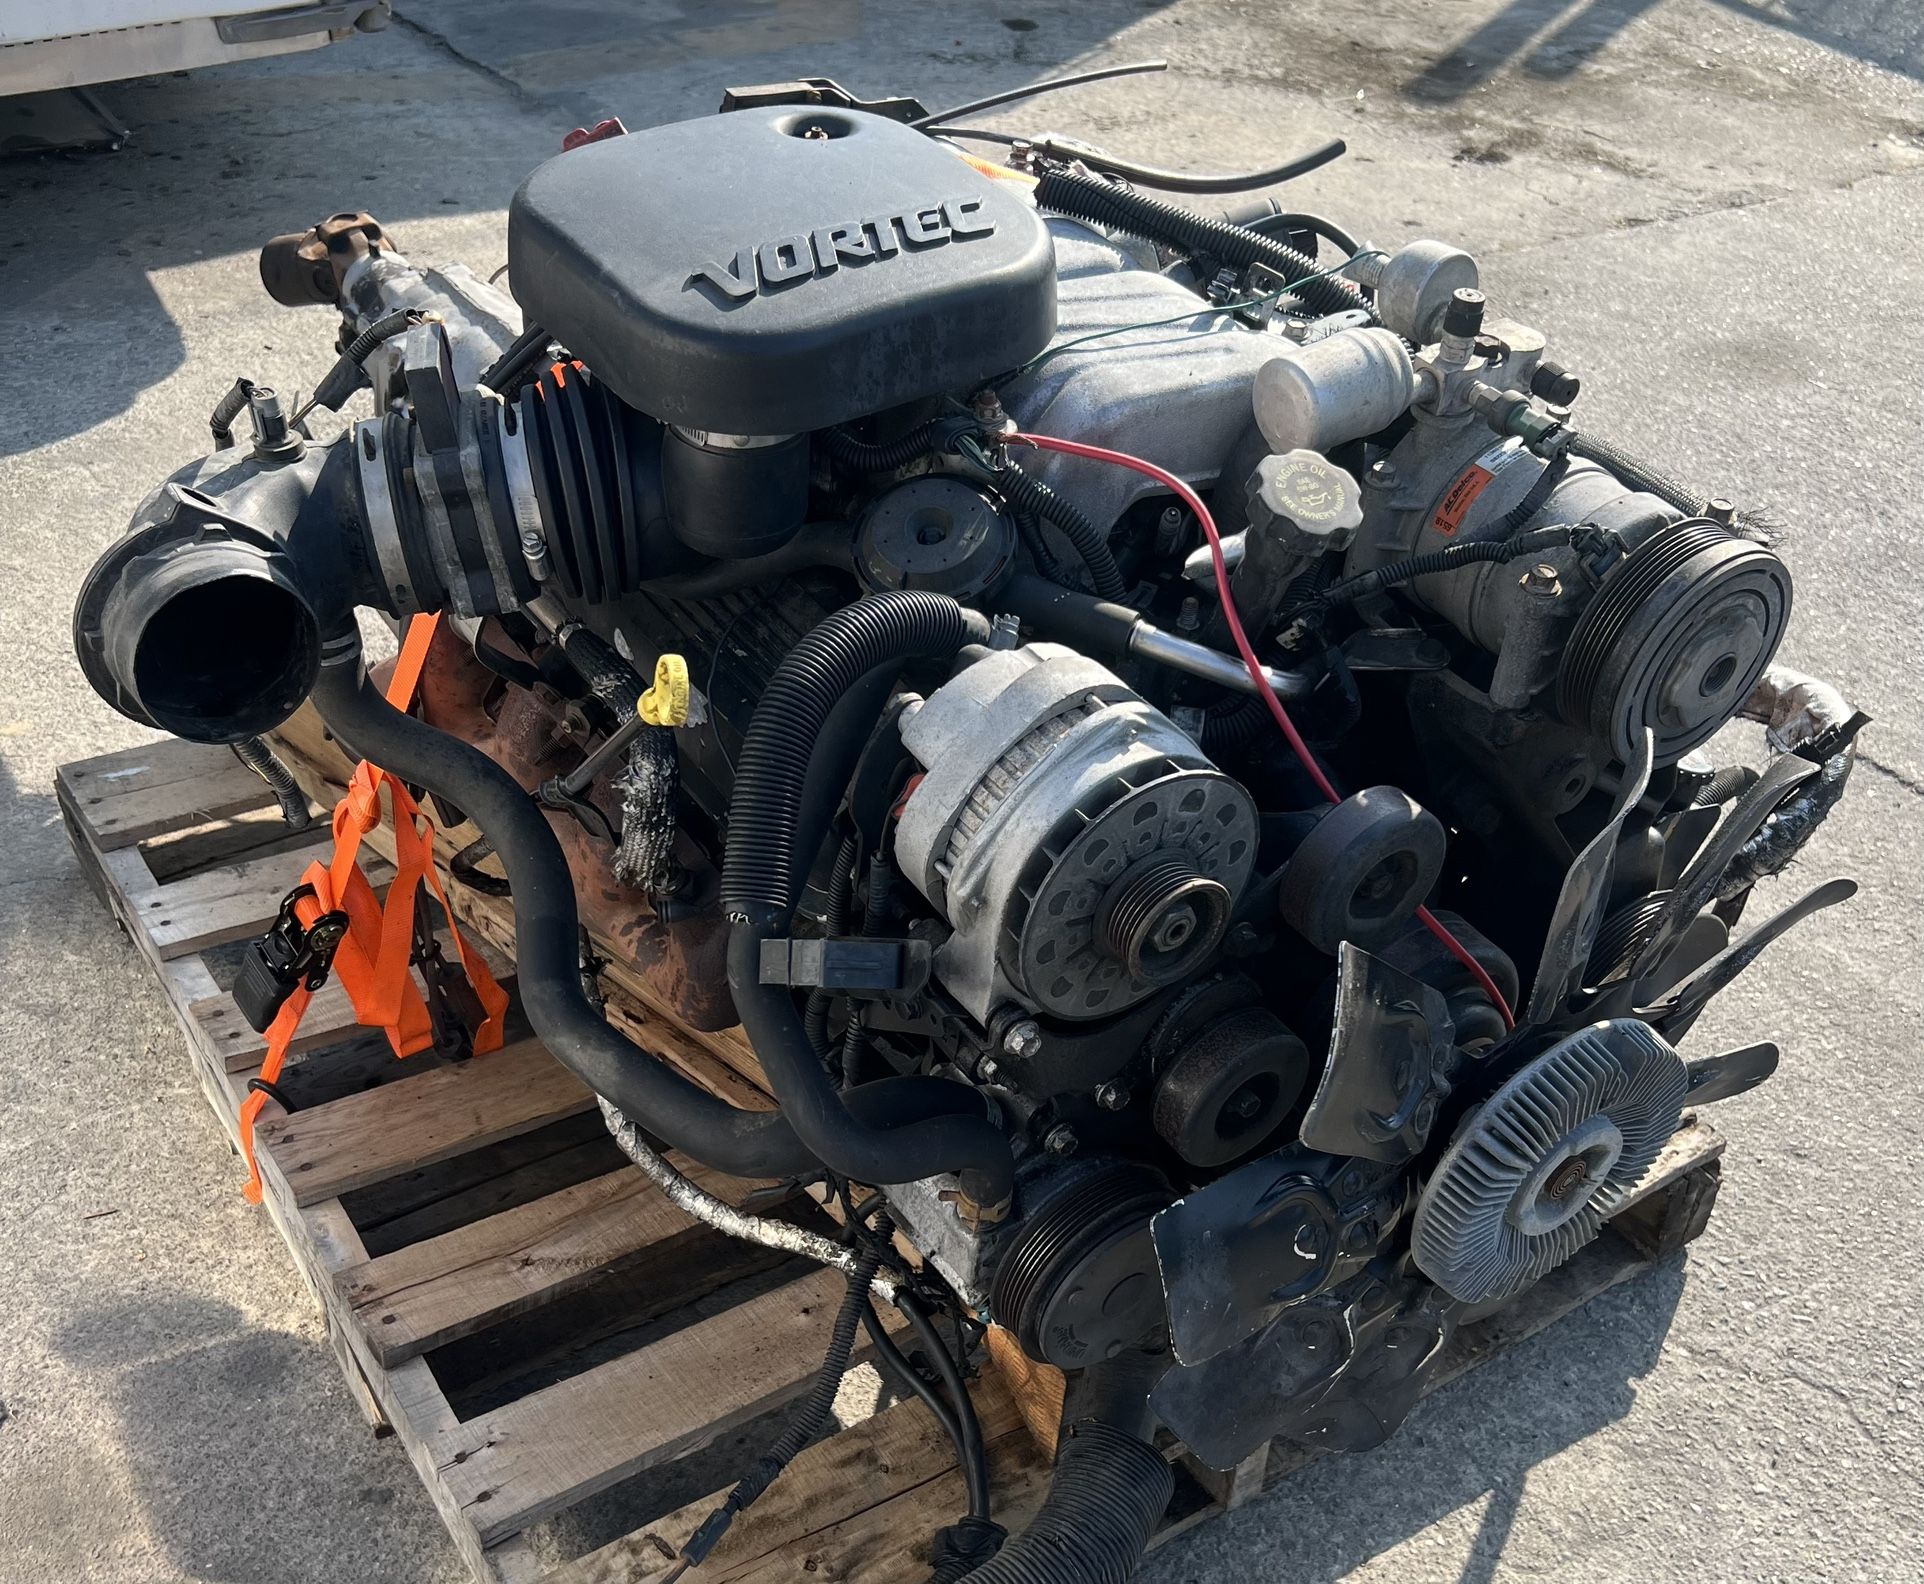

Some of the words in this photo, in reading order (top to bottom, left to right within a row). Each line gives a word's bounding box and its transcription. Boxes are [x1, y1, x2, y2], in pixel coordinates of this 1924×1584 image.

[687, 195, 997, 303] VORTEC
[1275, 462, 1307, 489] ENGINE
[1310, 464, 1326, 479] OIL
[1281, 495, 1298, 511] SEE
[1333, 481, 1345, 512] MANUAL
